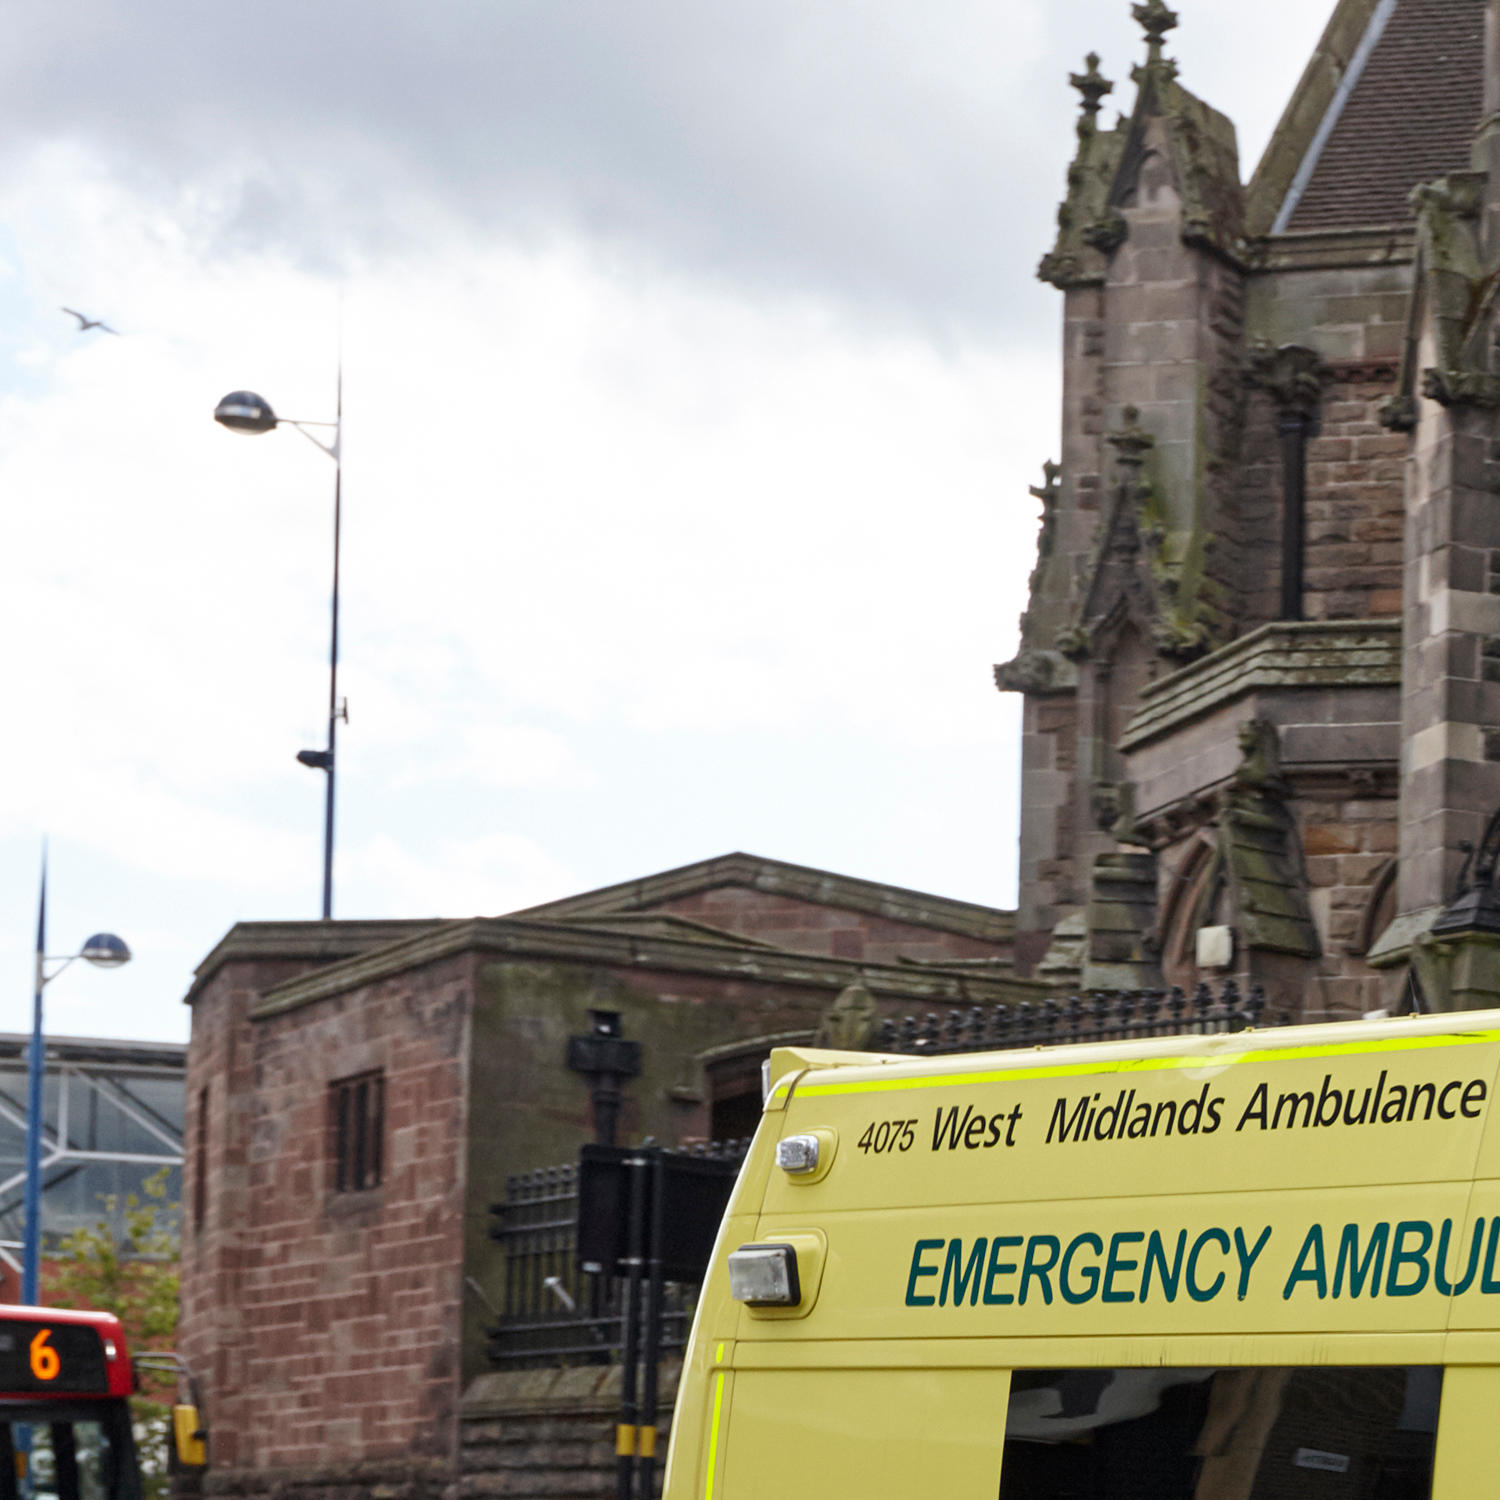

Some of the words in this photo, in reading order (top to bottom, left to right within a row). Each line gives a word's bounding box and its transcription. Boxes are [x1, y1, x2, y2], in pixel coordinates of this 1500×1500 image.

[857, 1119, 919, 1155] 4075
[931, 1103, 1023, 1152] West
[1045, 1082, 1226, 1144] Midlands
[1235, 1069, 1487, 1132] Ambulance
[905, 1225, 1273, 1306] EMERGENCY
[30, 1328, 60, 1380] 6
